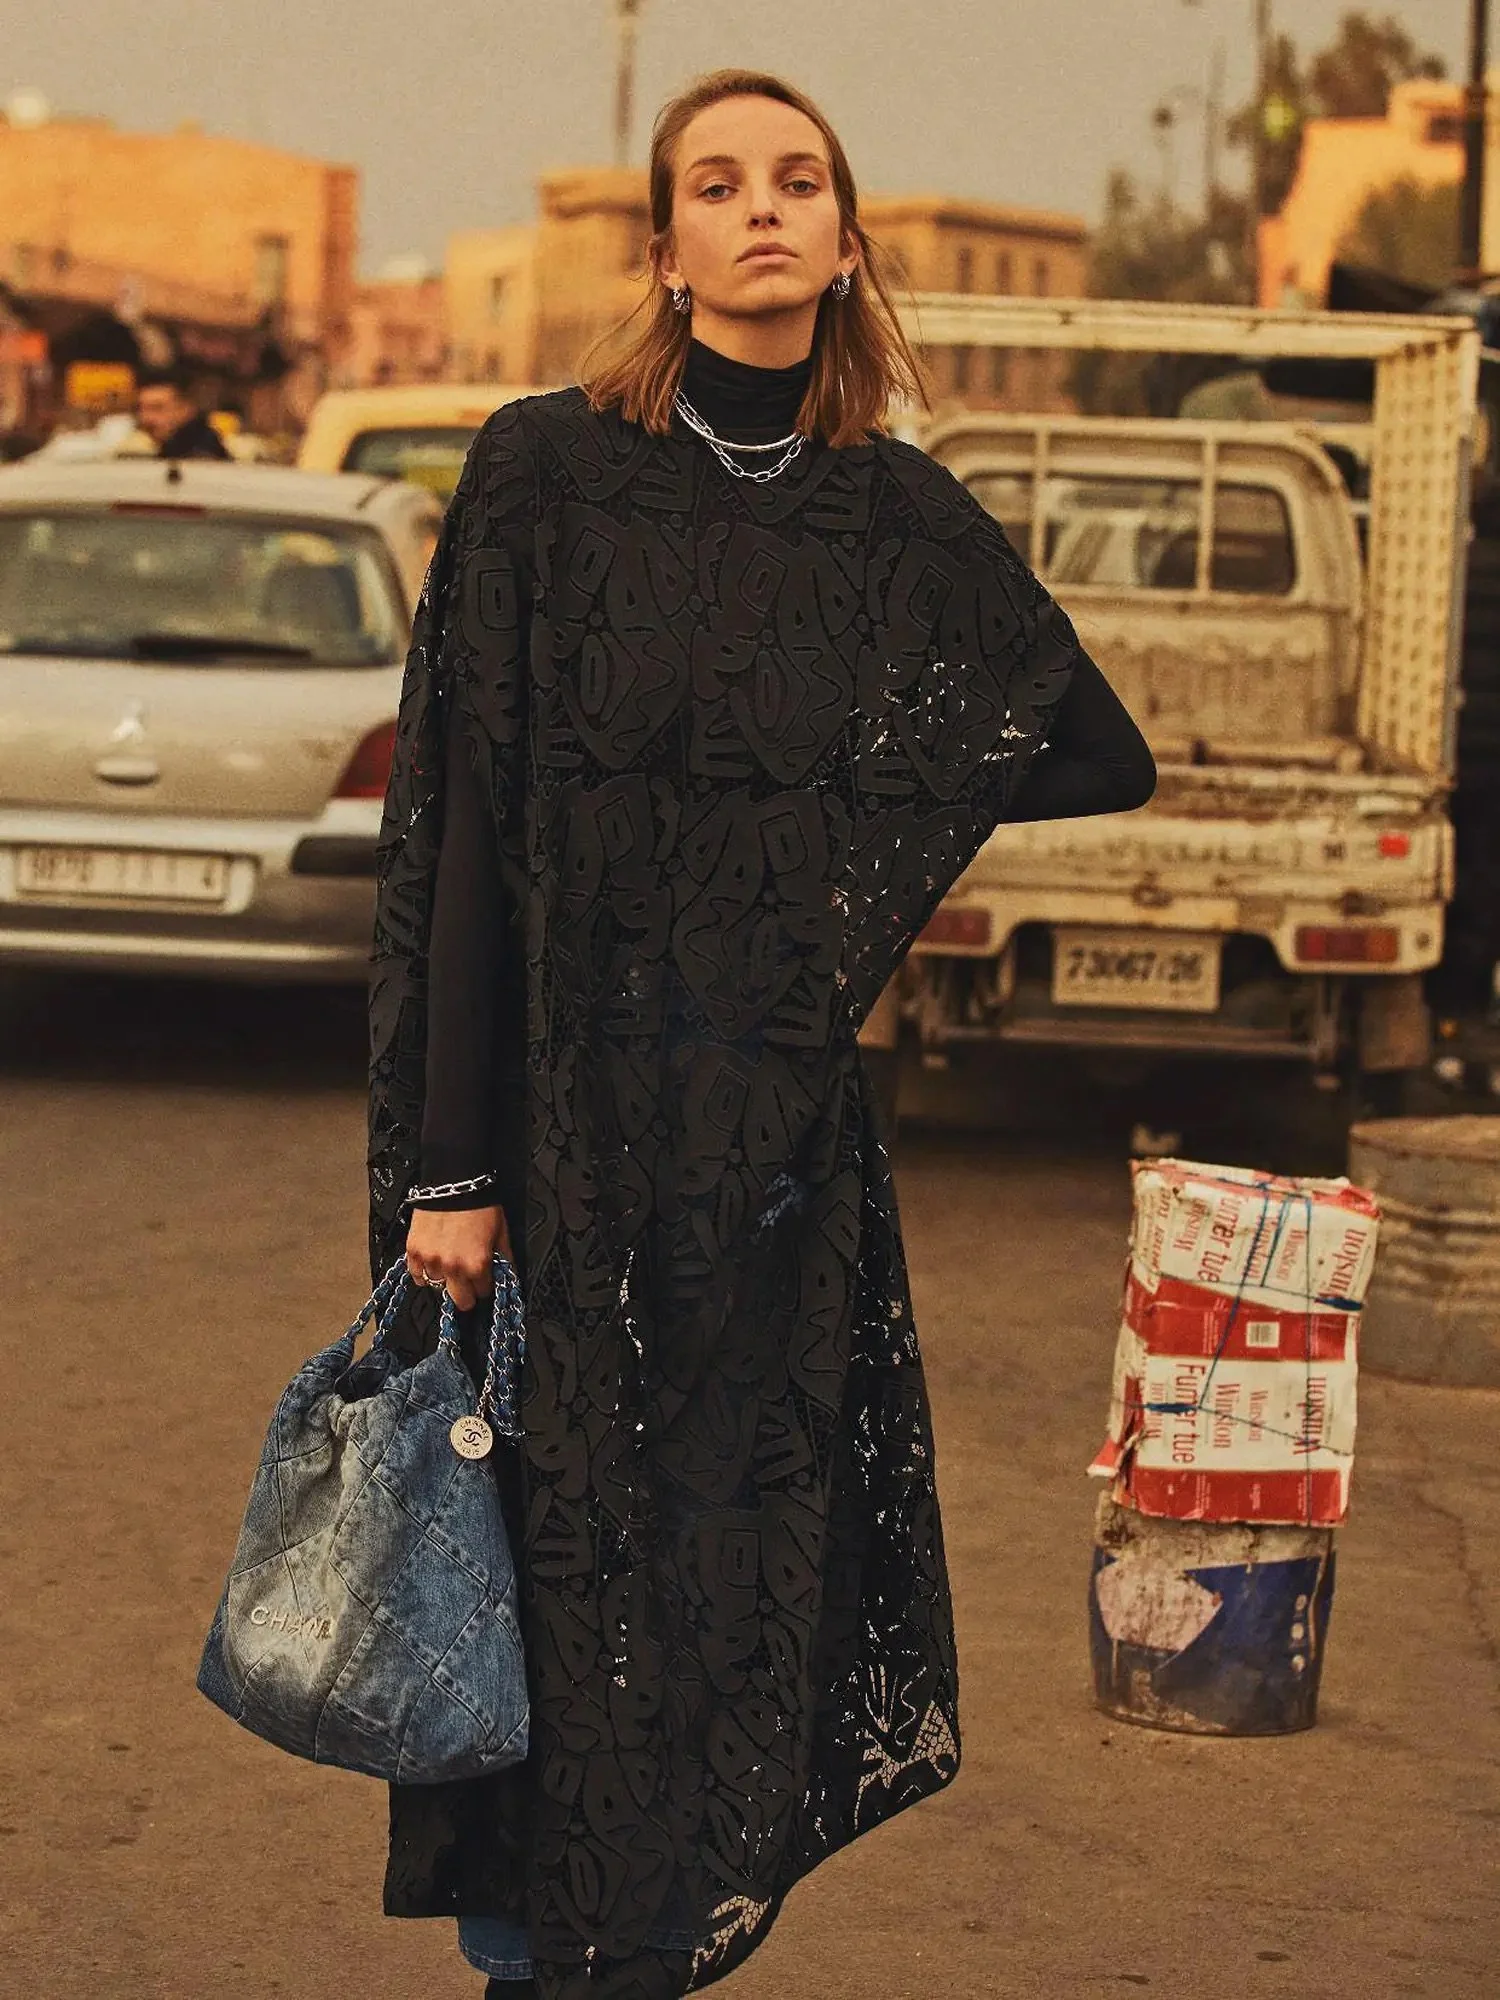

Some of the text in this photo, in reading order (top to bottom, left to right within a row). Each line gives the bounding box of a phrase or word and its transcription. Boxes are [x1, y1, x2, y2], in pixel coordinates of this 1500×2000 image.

[1211, 1195, 1249, 1249] umer
[1212, 1383, 1241, 1449] Winston
[1248, 1389, 1269, 1442] Winston
[1292, 1376, 1328, 1456] Winston
[1172, 1433, 1201, 1465] tue
